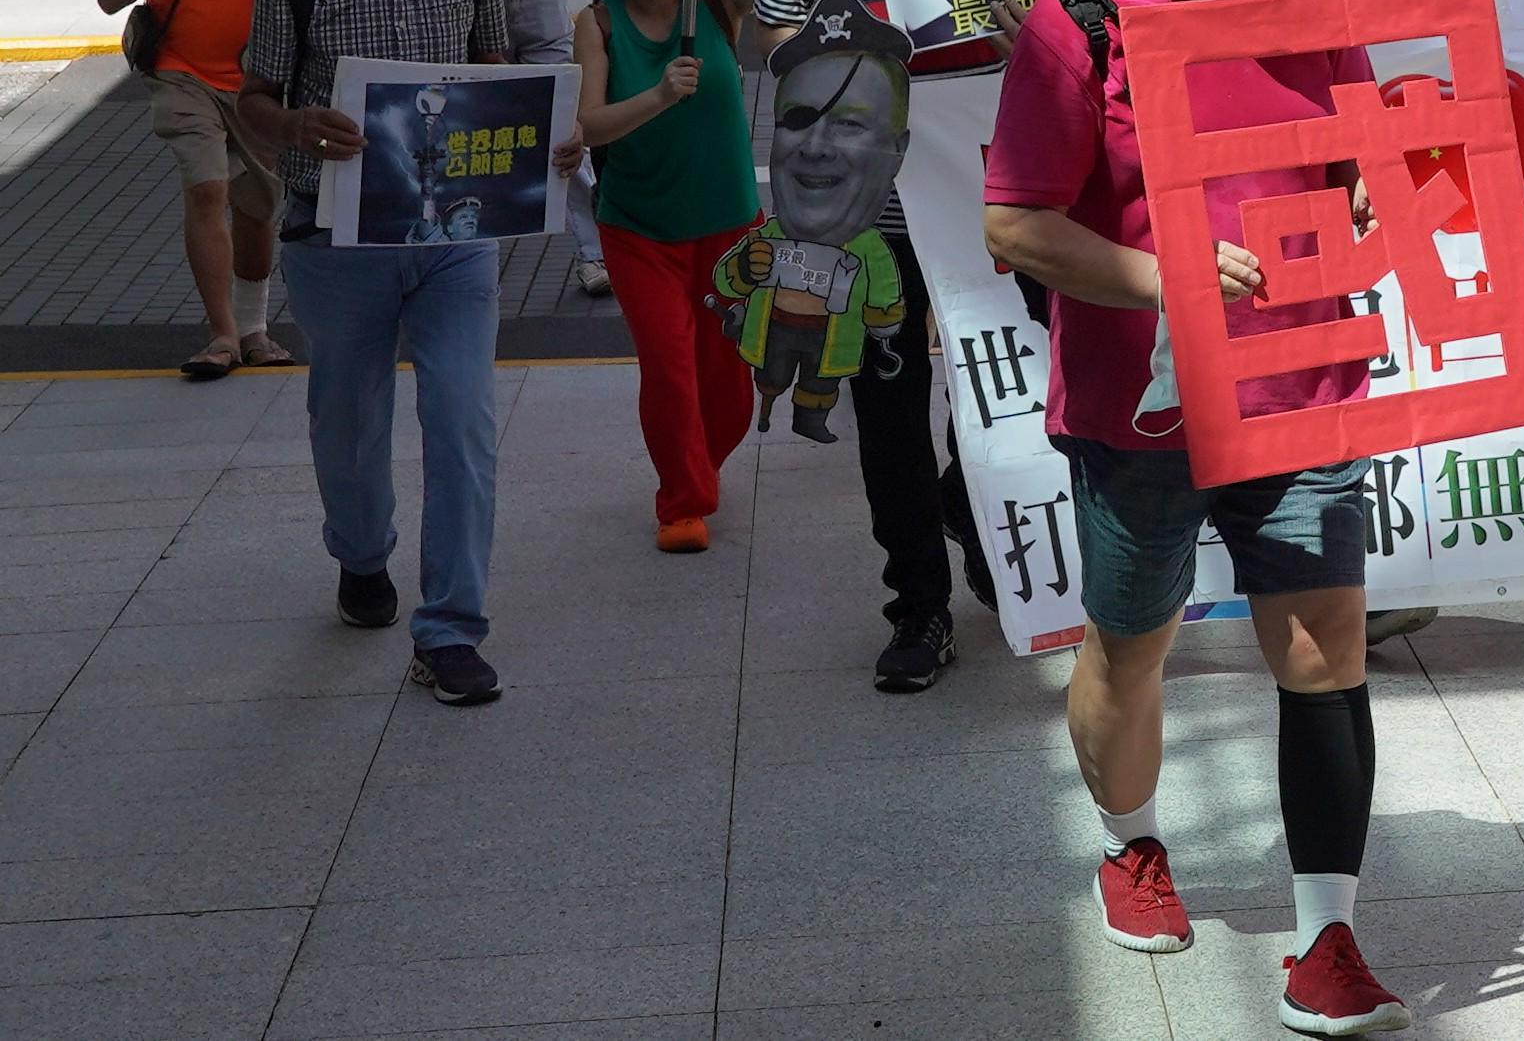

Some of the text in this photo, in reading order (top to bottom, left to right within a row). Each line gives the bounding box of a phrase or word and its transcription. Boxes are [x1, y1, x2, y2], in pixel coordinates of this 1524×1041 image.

[447, 125, 537, 153] 世界魔鬼
[446, 151, 514, 177] 凸朗普
[955, 325, 1046, 429] 世
